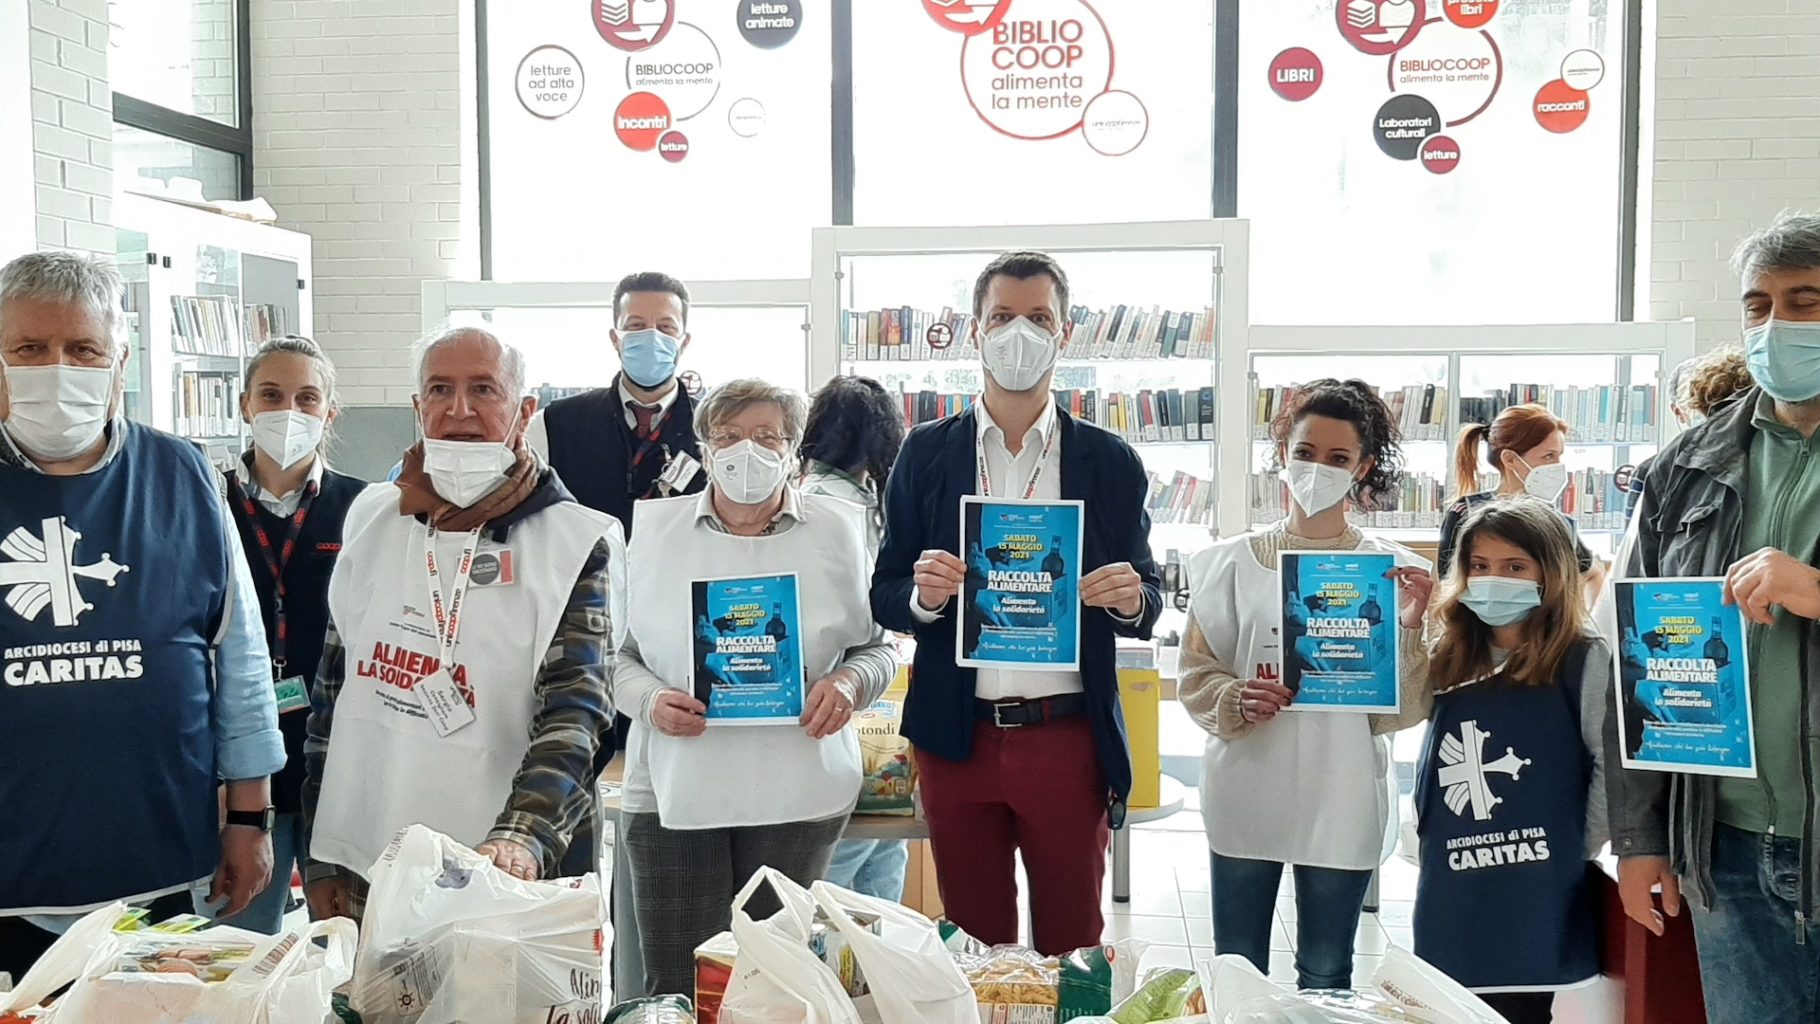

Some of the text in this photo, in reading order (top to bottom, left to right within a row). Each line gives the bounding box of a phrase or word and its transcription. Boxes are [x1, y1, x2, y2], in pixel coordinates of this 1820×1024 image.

[751, 3, 788, 14] letture
[1460, 3, 1483, 15] libri
[745, 16, 794, 29] animate
[993, 19, 1083, 45] BIBLIO
[991, 45, 1083, 70] COOP
[530, 65, 572, 76] letture
[635, 63, 713, 76] BIBLIOCOOP
[1400, 58, 1490, 72] BIBLIOCOOP
[991, 72, 1083, 91] alimenta
[1276, 69, 1315, 83] LIBRI
[1400, 73, 1489, 84] alimenta la mente
[528, 78, 546, 89] ad
[635, 77, 674, 87] alimenta
[535, 92, 568, 102] voce
[992, 92, 1083, 110] la mente
[1537, 101, 1585, 112] racconti
[617, 116, 668, 130] incontri
[1379, 117, 1432, 129] Laboratori
[1385, 128, 1426, 139] culturali
[660, 143, 688, 153] letture
[1423, 150, 1457, 160] letture
[1004, 534, 1037, 542] SABATO
[1009, 543, 1043, 551] MAGGIO
[1010, 551, 1030, 559] 2021
[987, 570, 1052, 583] RACCOLTA
[987, 581, 1052, 592] ALIMENTARE
[1001, 597, 1036, 605] Alimenta
[1306, 617, 1370, 629] RACCOLTA
[1659, 616, 1695, 625] SABATO
[1306, 628, 1370, 638] ALIMENTARE
[1666, 625, 1703, 634] MAGGIO
[716, 635, 776, 646] RACCOLTA
[1668, 635, 1690, 644] 2021
[4, 639, 142, 660] ARCIDIOCESI di PISA
[716, 644, 777, 653] ALIMENTARE
[357, 660, 377, 679] LA
[1646, 657, 1717, 672] RACCOLTA
[4, 655, 144, 687] CARITAS
[1646, 670, 1718, 683] ALIMENTARE
[1663, 688, 1702, 698] Alimenta
[1655, 697, 1663, 706] la
[1446, 826, 1546, 850] ARCIDIOCESI di PISA
[1448, 840, 1550, 871] CARITAS
